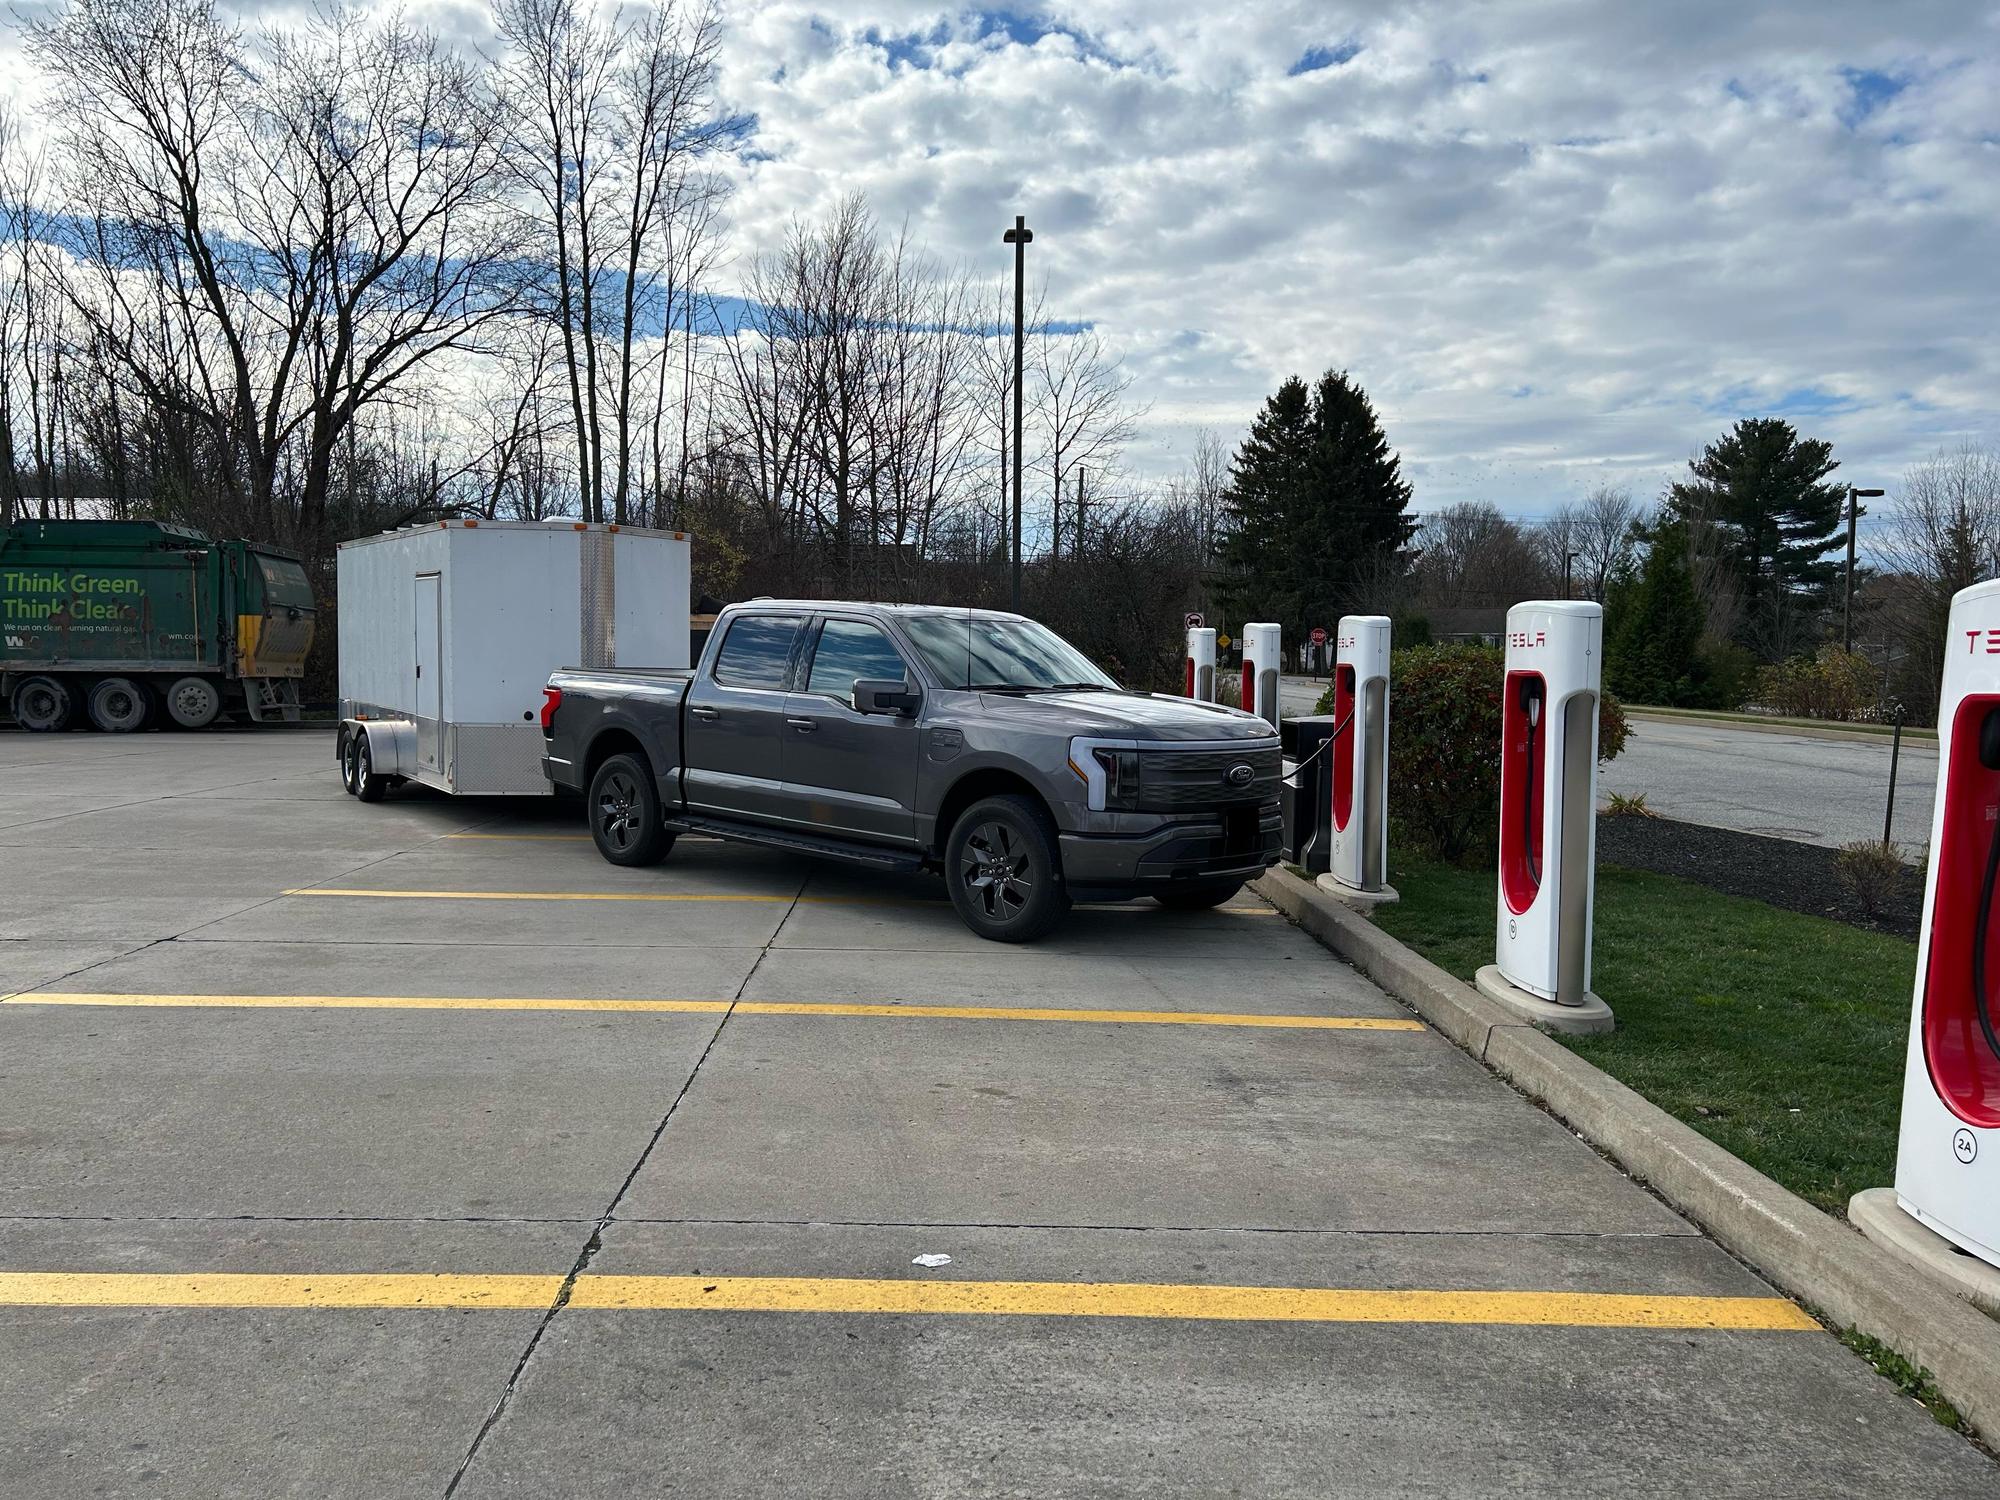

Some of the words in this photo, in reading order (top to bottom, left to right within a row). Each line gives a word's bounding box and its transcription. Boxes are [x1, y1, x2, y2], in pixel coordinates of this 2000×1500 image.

[3, 572, 67, 592] Think
[70, 574, 146, 596] Green,
[3, 599, 65, 618] Think
[1338, 638, 1354, 648] ESLA
[1508, 632, 1545, 648] TESLA
[1957, 1138, 1972, 1154] 2A
